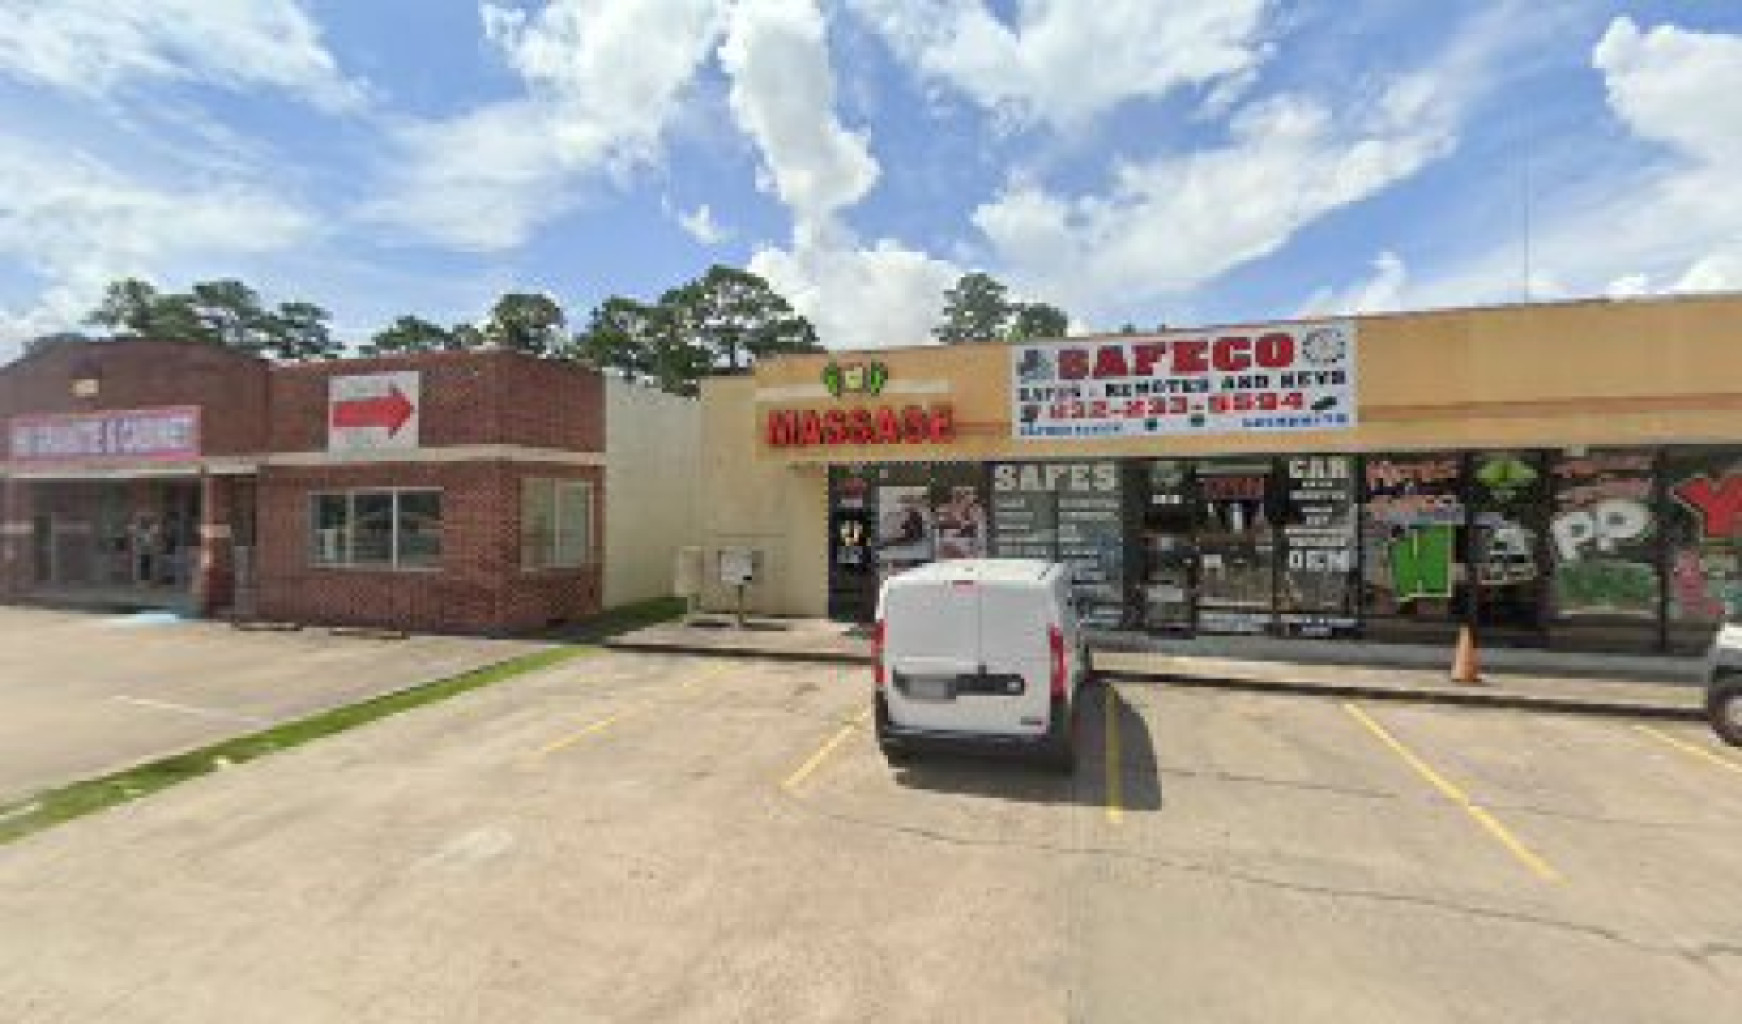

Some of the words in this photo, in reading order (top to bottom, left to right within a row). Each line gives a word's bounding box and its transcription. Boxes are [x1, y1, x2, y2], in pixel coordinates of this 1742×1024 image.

[1057, 332, 1296, 380] SAFECO
[1220, 375, 1270, 390] AND
[1279, 369, 1347, 389] KEYS
[766, 404, 955, 446] MASSAGE
[994, 461, 1118, 491] SAFES
[1287, 456, 1350, 479] CAR
[1288, 549, 1350, 573] OEM
